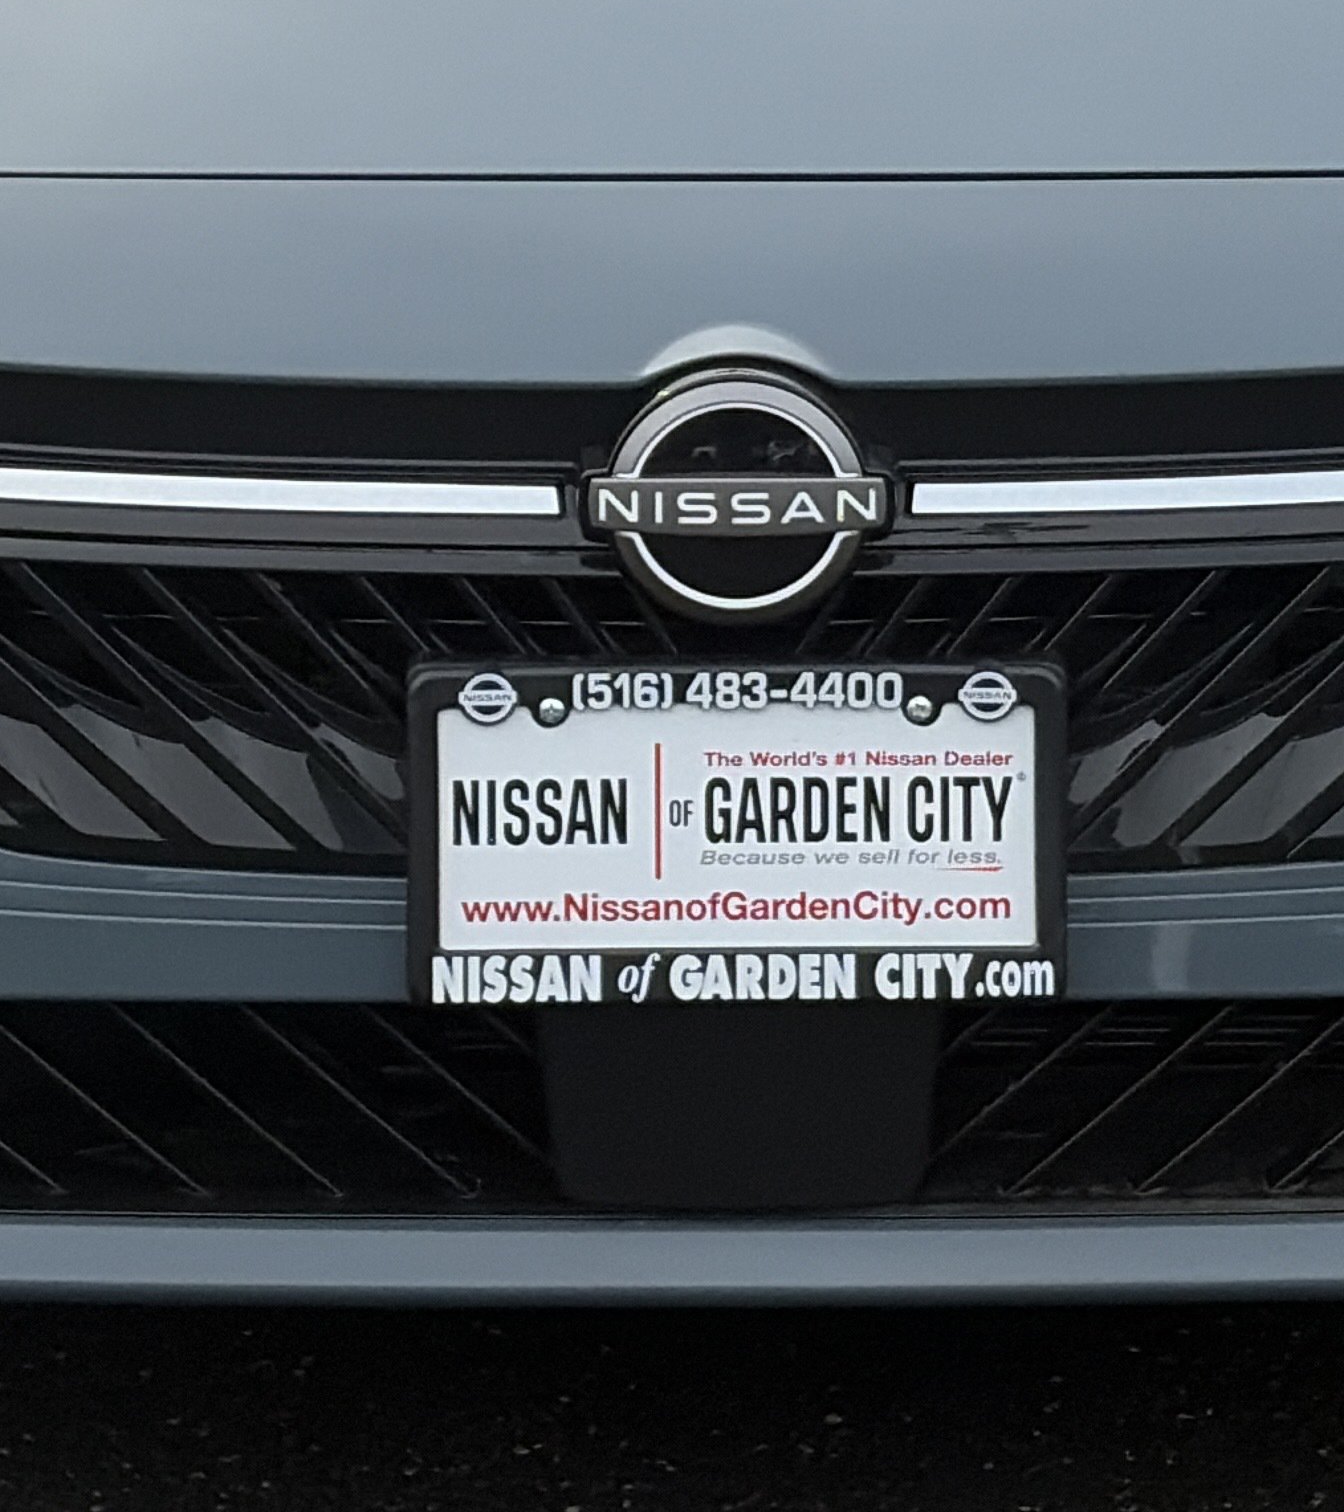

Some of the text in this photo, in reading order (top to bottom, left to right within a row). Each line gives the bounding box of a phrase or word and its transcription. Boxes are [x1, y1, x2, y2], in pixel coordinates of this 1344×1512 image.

[598, 487, 877, 525] NISSAN
[572, 672, 903, 710] (516) 483-4400
[704, 750, 1014, 767] The World's #1 Nissan Dealer
[453, 776, 1013, 846] NISSAN OF GARDEN CITY
[699, 849, 1002, 865] Because we sell for less.
[460, 890, 1011, 926] www.NissanofGardenCity.com
[432, 952, 1055, 1004] NISSAN of GARDEN CITY.com
